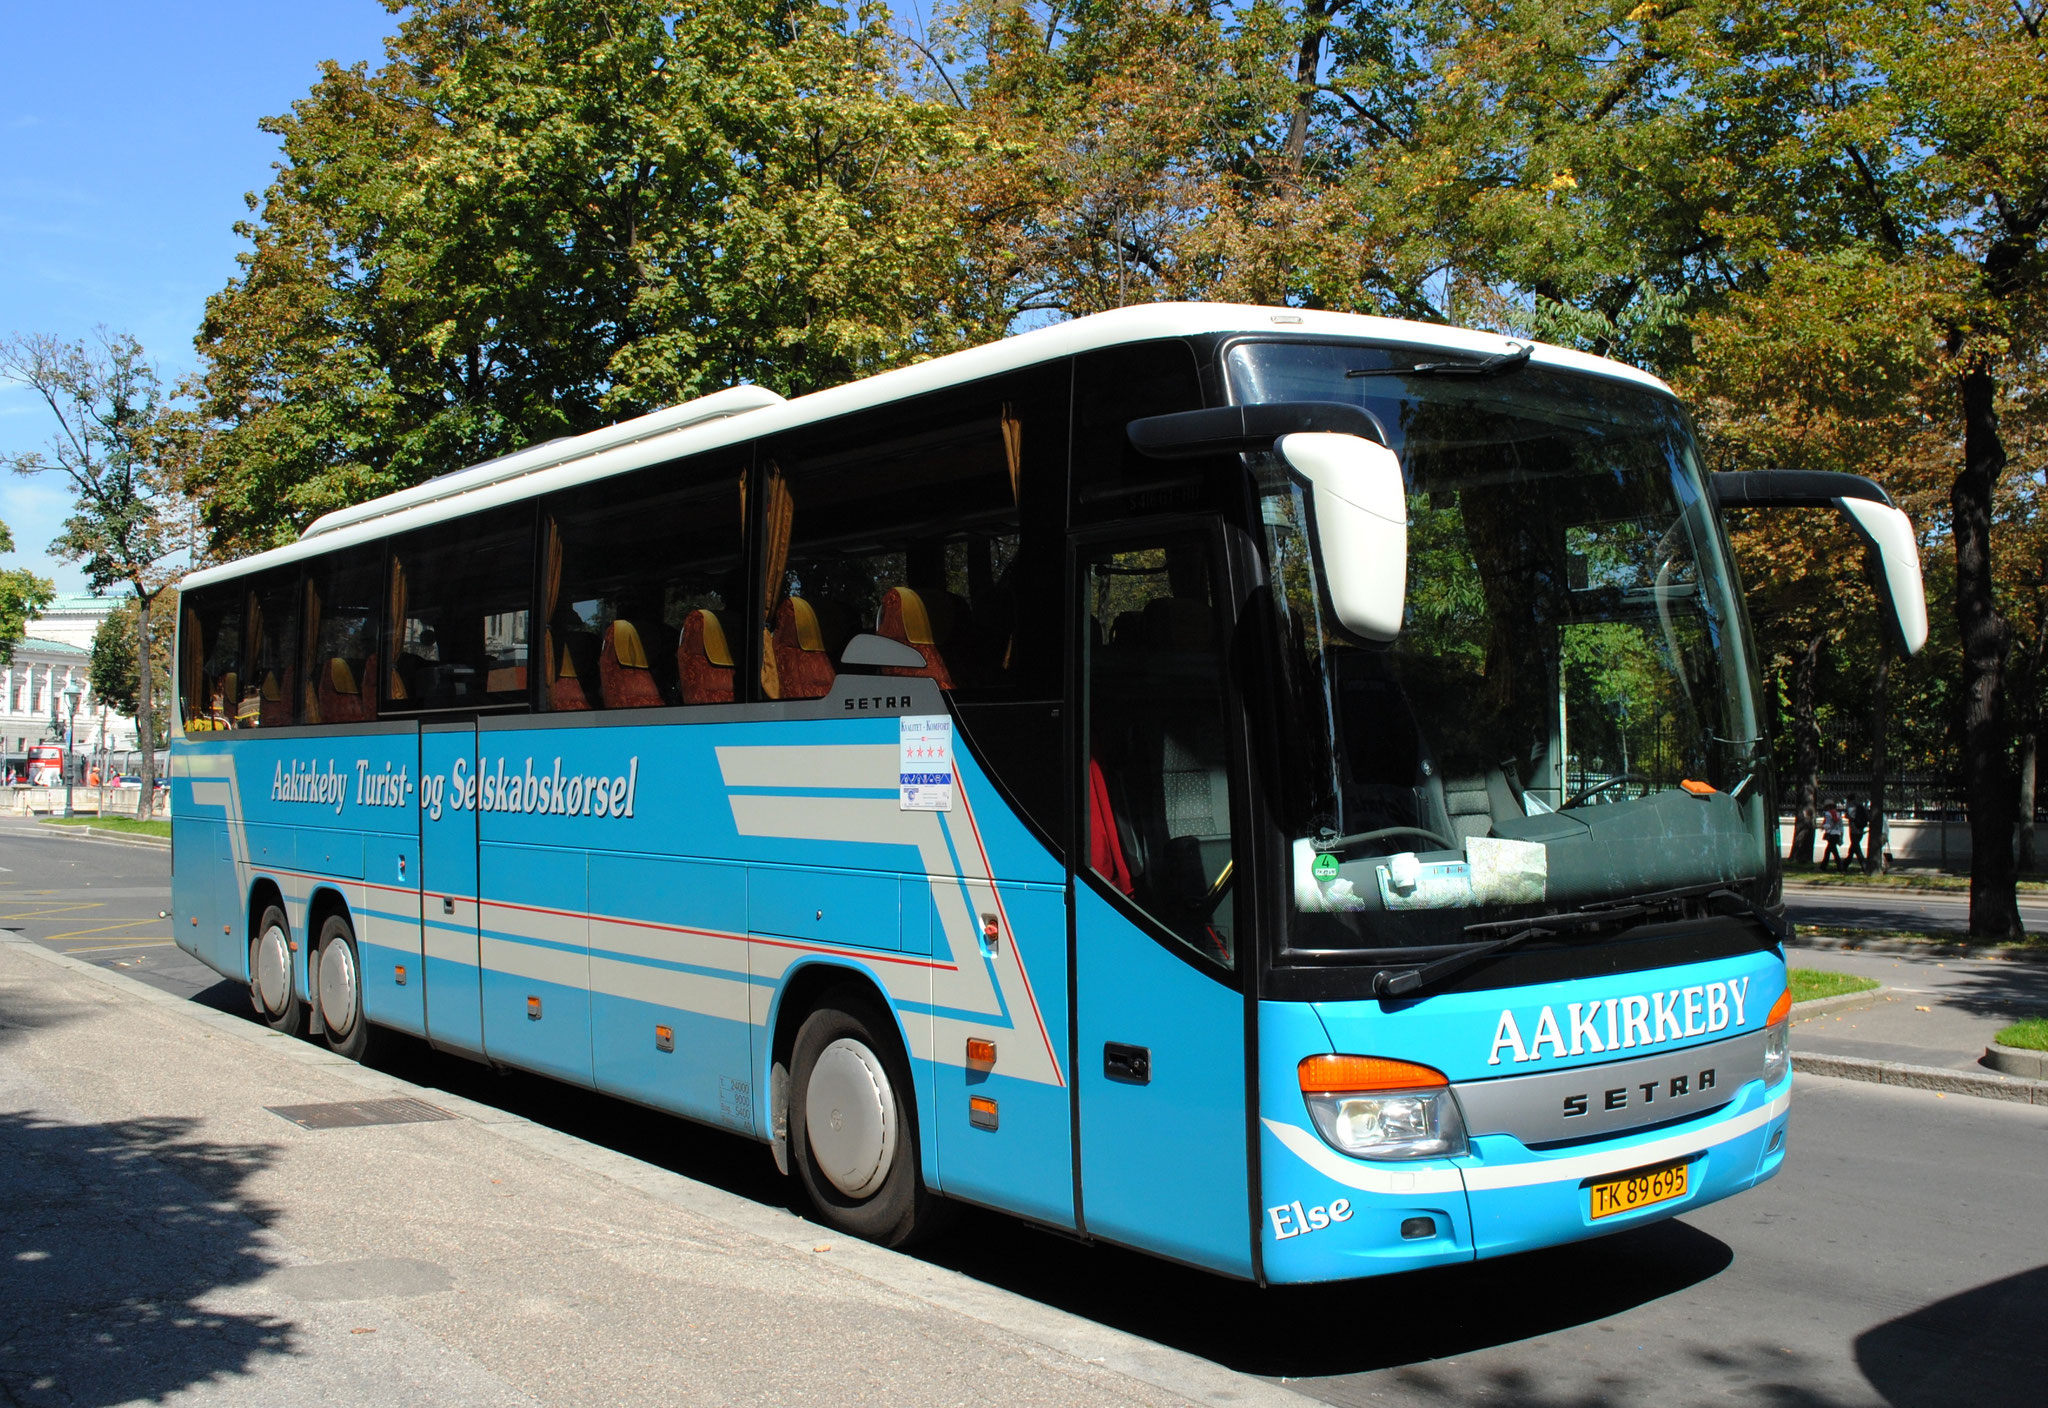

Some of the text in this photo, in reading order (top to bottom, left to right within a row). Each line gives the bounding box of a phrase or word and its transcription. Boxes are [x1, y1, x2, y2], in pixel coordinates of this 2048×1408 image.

[845, 696, 911, 710] SETRA
[271, 755, 640, 821] Aakirkeby Turist- og Selskabskørsel
[1321, 855, 1330, 868] 4
[1488, 976, 1749, 1065] AAKIRKEBY
[1563, 1068, 1716, 1118] SETRA
[1596, 1183, 1621, 1211] TK
[1268, 1198, 1354, 1240] Else
